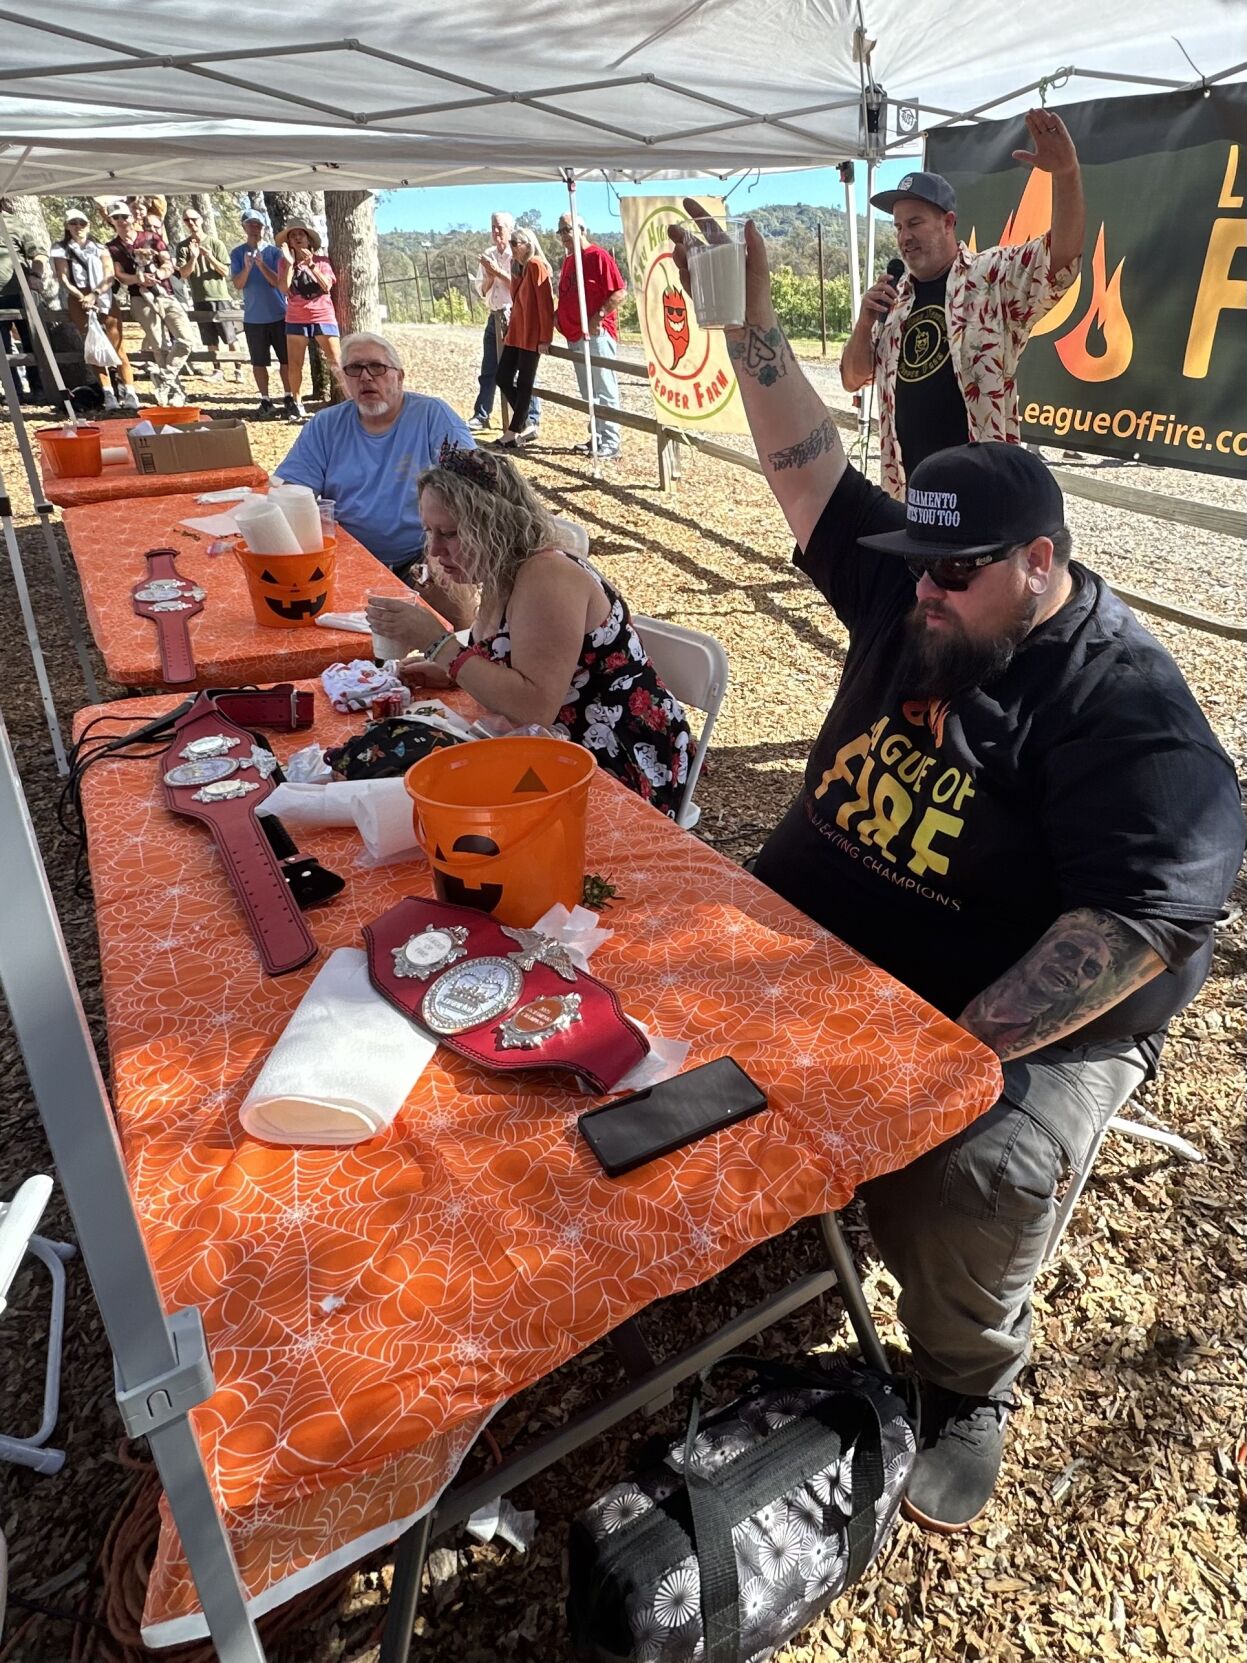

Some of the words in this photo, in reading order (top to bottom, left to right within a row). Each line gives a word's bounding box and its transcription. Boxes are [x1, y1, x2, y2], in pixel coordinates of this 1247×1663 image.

[647, 220, 668, 251] HIG
[648, 361, 690, 410] PEPPER
[693, 367, 730, 409] FARM
[908, 487, 957, 510] RAMENTO
[919, 507, 936, 525] YOU
[937, 509, 961, 528] TOO
[819, 823, 860, 859] EATING
[862, 855, 962, 912] CHAMPIONS
